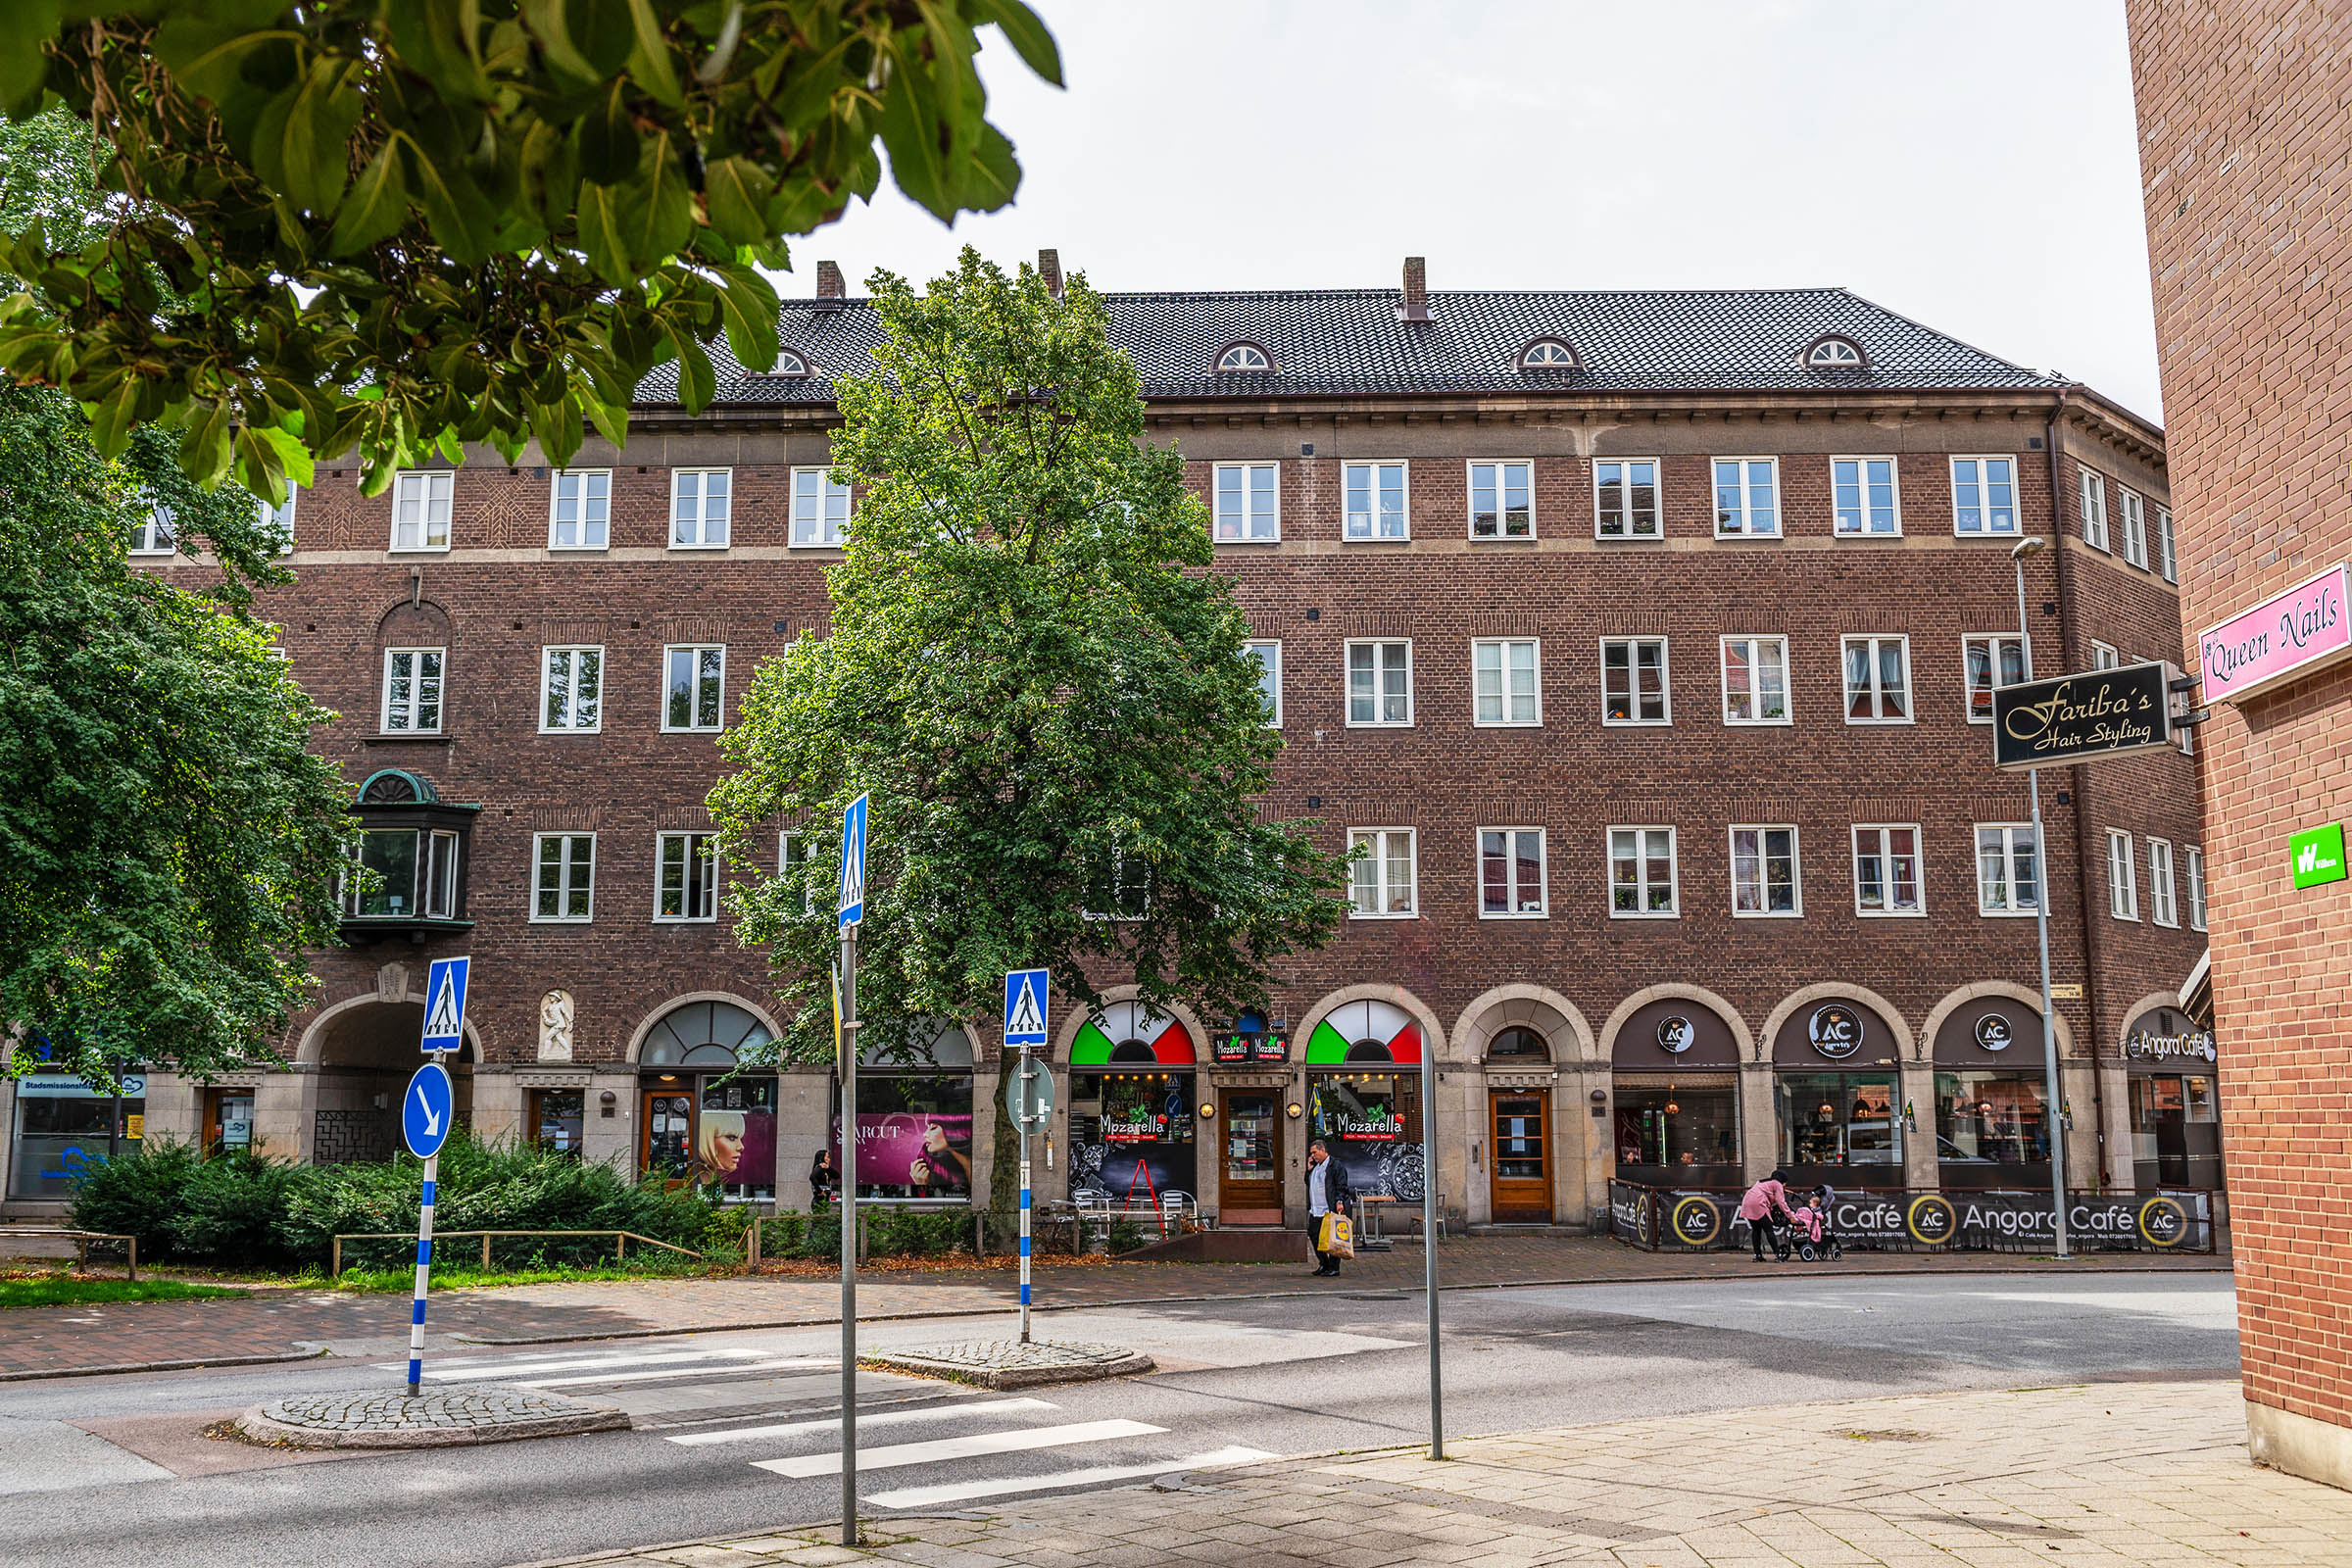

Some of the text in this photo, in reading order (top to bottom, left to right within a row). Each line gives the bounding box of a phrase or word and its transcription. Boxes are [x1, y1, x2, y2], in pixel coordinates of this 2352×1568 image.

[2212, 587, 2337, 682] Queen Nails
[2034, 718, 2151, 751] Hair Styling
[1823, 1021, 1852, 1041] AC
[1984, 1025, 2005, 1039] AC
[1216, 1040, 1248, 1054] Mozarella
[1254, 1038, 1285, 1054] Mozarella
[2141, 1030, 2180, 1060] Angora
[2180, 1033, 2204, 1056] Café
[1100, 1113, 1164, 1133] Mozarella
[1337, 1113, 1402, 1132] Mozarella
[837, 1126, 900, 1139] SARCUT
[1686, 1213, 1708, 1228] AC
[1838, 1203, 1902, 1229] Café
[1921, 1212, 1944, 1227] AC
[2070, 1205, 2133, 1230] Café
[2152, 1214, 2175, 1229] AC
